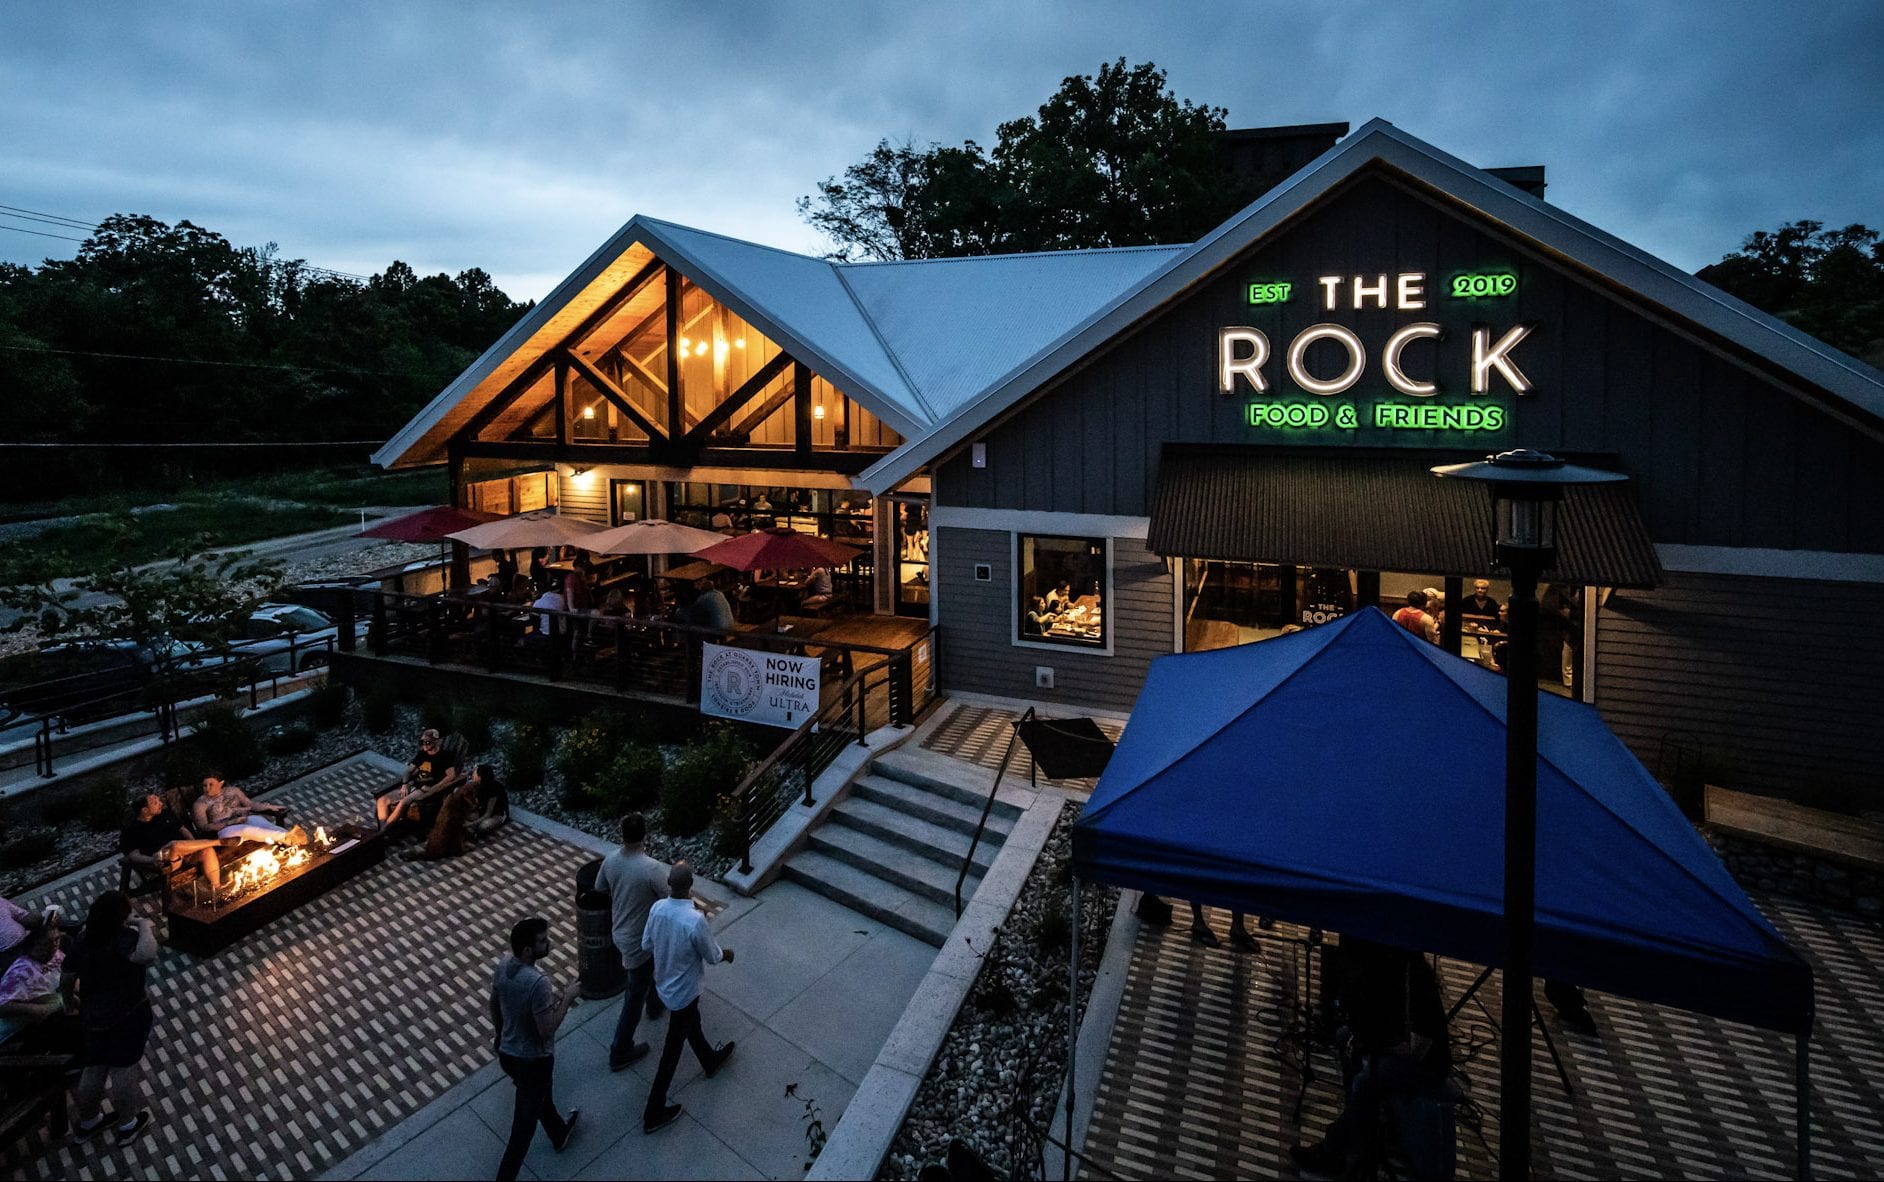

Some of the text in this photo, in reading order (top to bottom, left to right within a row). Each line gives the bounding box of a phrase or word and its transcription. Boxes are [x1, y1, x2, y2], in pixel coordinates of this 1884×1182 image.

[1251, 282, 1290, 301] EST
[1318, 272, 1426, 311] THE
[1455, 274, 1516, 295] 2019
[1218, 322, 1538, 397] ROCK
[1252, 405, 1503, 429] FOOD & FRIENDS
[1318, 603, 1335, 611] THE
[1303, 610, 1344, 624] ROC
[766, 658, 803, 674] NOW
[765, 672, 816, 690] HIRING
[769, 697, 810, 713] ULTRA
